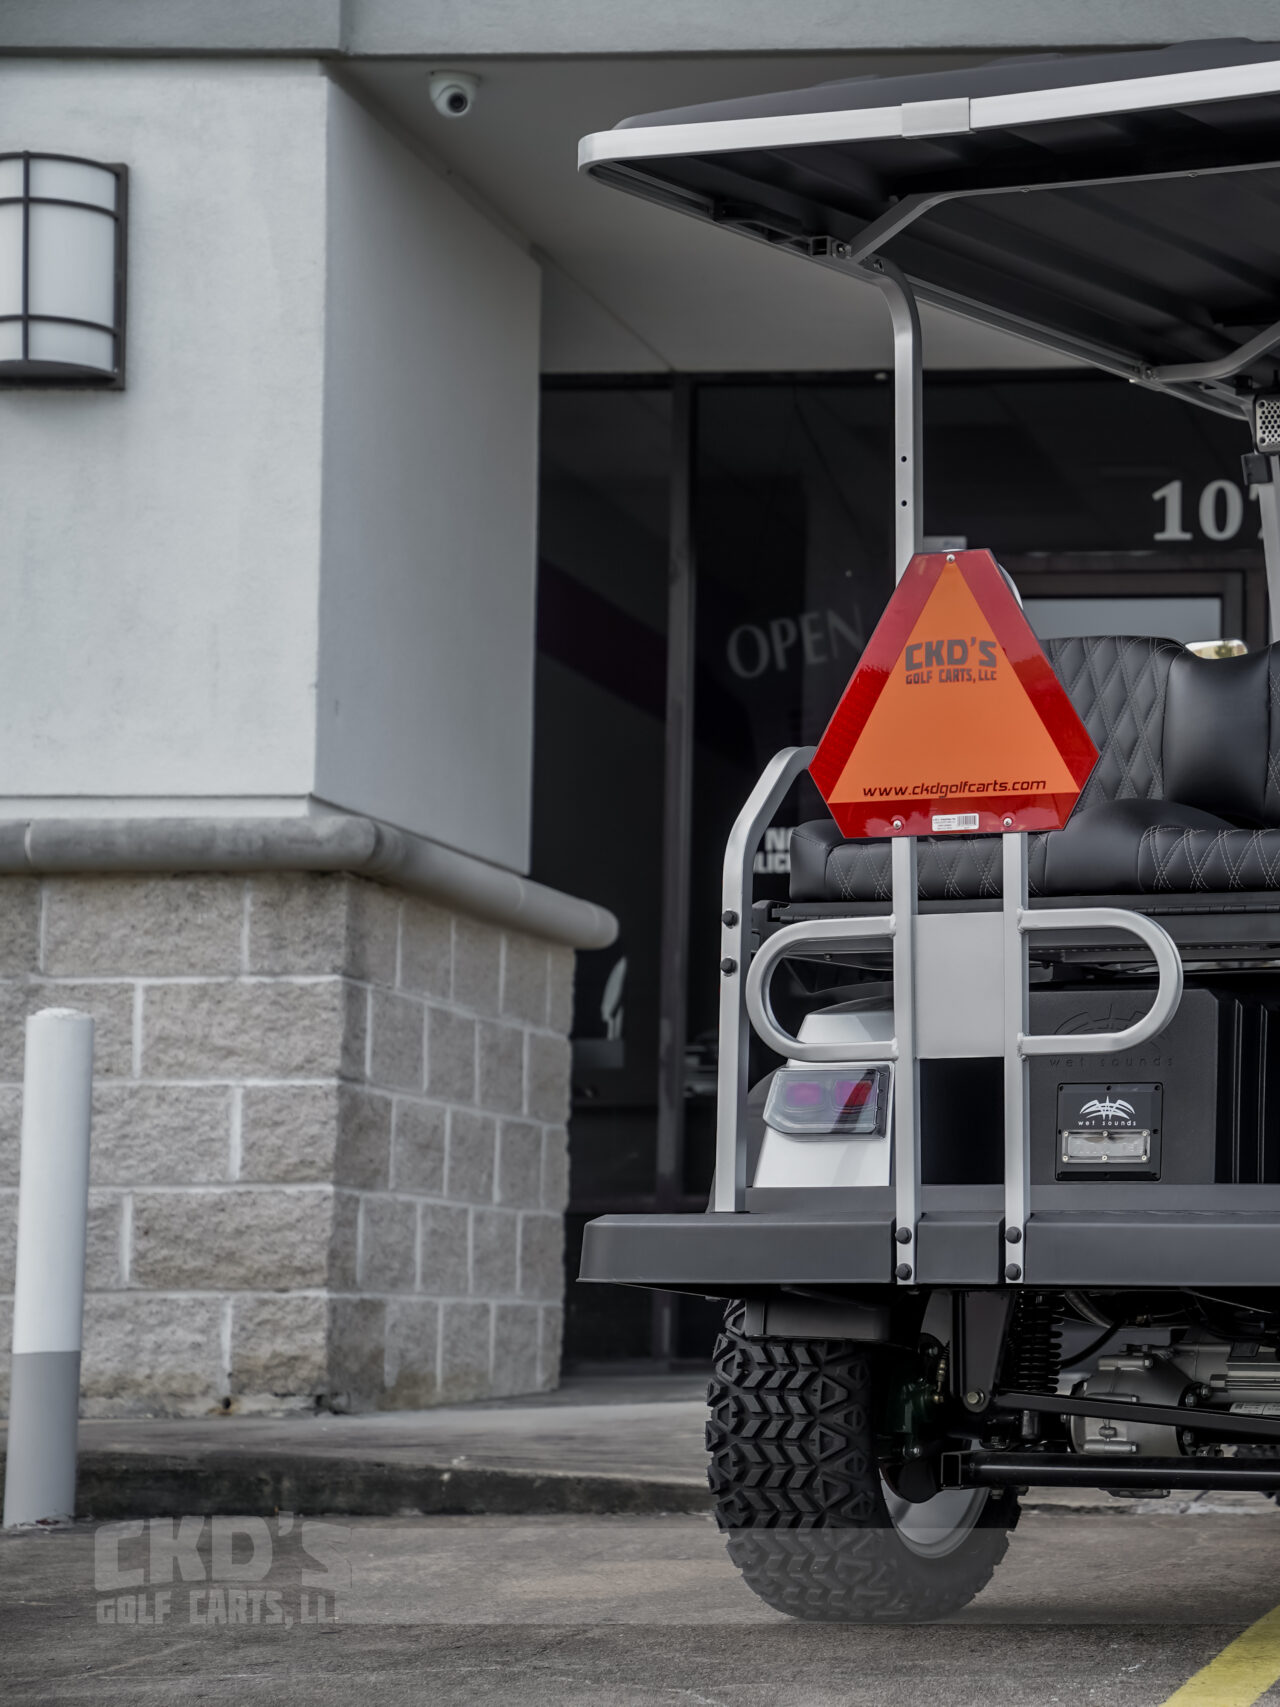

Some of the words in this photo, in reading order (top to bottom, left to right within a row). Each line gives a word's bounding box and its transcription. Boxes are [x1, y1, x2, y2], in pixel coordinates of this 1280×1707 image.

[727, 603, 867, 679] OPEN
[905, 637, 997, 672] CKD'S
[905, 671, 932, 685] GOLF
[938, 669, 976, 684] CARTS,
[978, 669, 997, 681] LLC
[863, 780, 1047, 799] www.ckdgolfcarts.com
